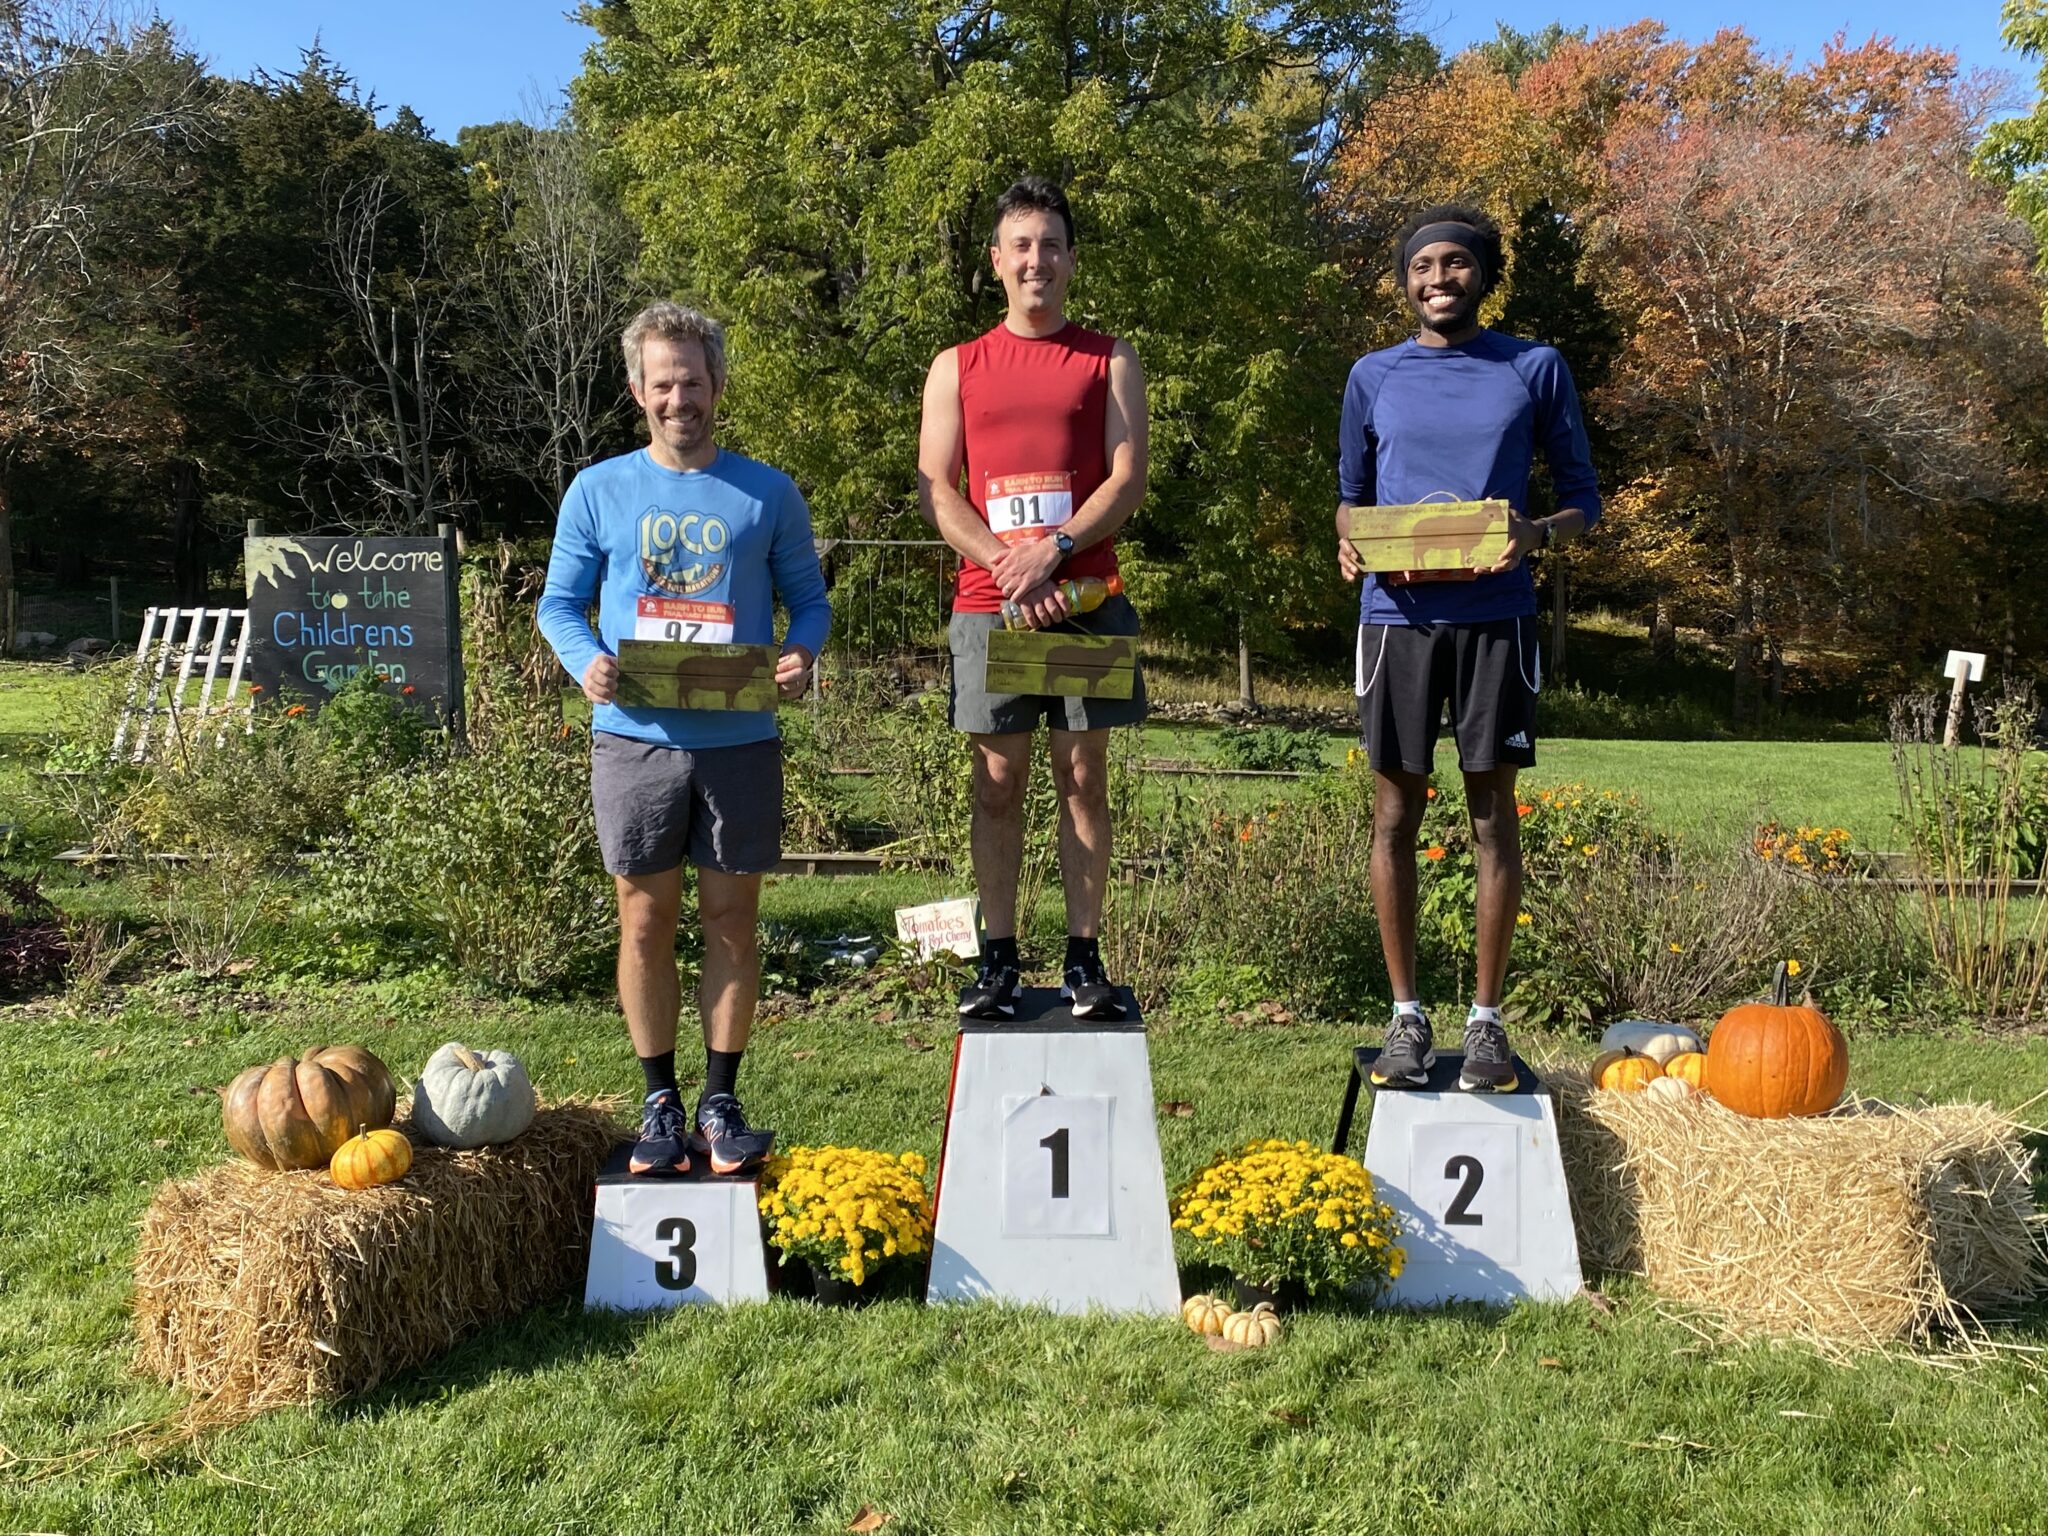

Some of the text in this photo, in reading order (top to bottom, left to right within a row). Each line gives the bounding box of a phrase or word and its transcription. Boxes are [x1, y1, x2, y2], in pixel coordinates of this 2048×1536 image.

[1010, 495, 1044, 526] 91
[302, 540, 444, 573] Welcome
[358, 576, 411, 608] the
[273, 611, 414, 647] Childrens
[665, 621, 703, 642] 97
[1039, 1128, 1069, 1198] 1
[1444, 1155, 1484, 1226] 2
[655, 1217, 696, 1291] 3
